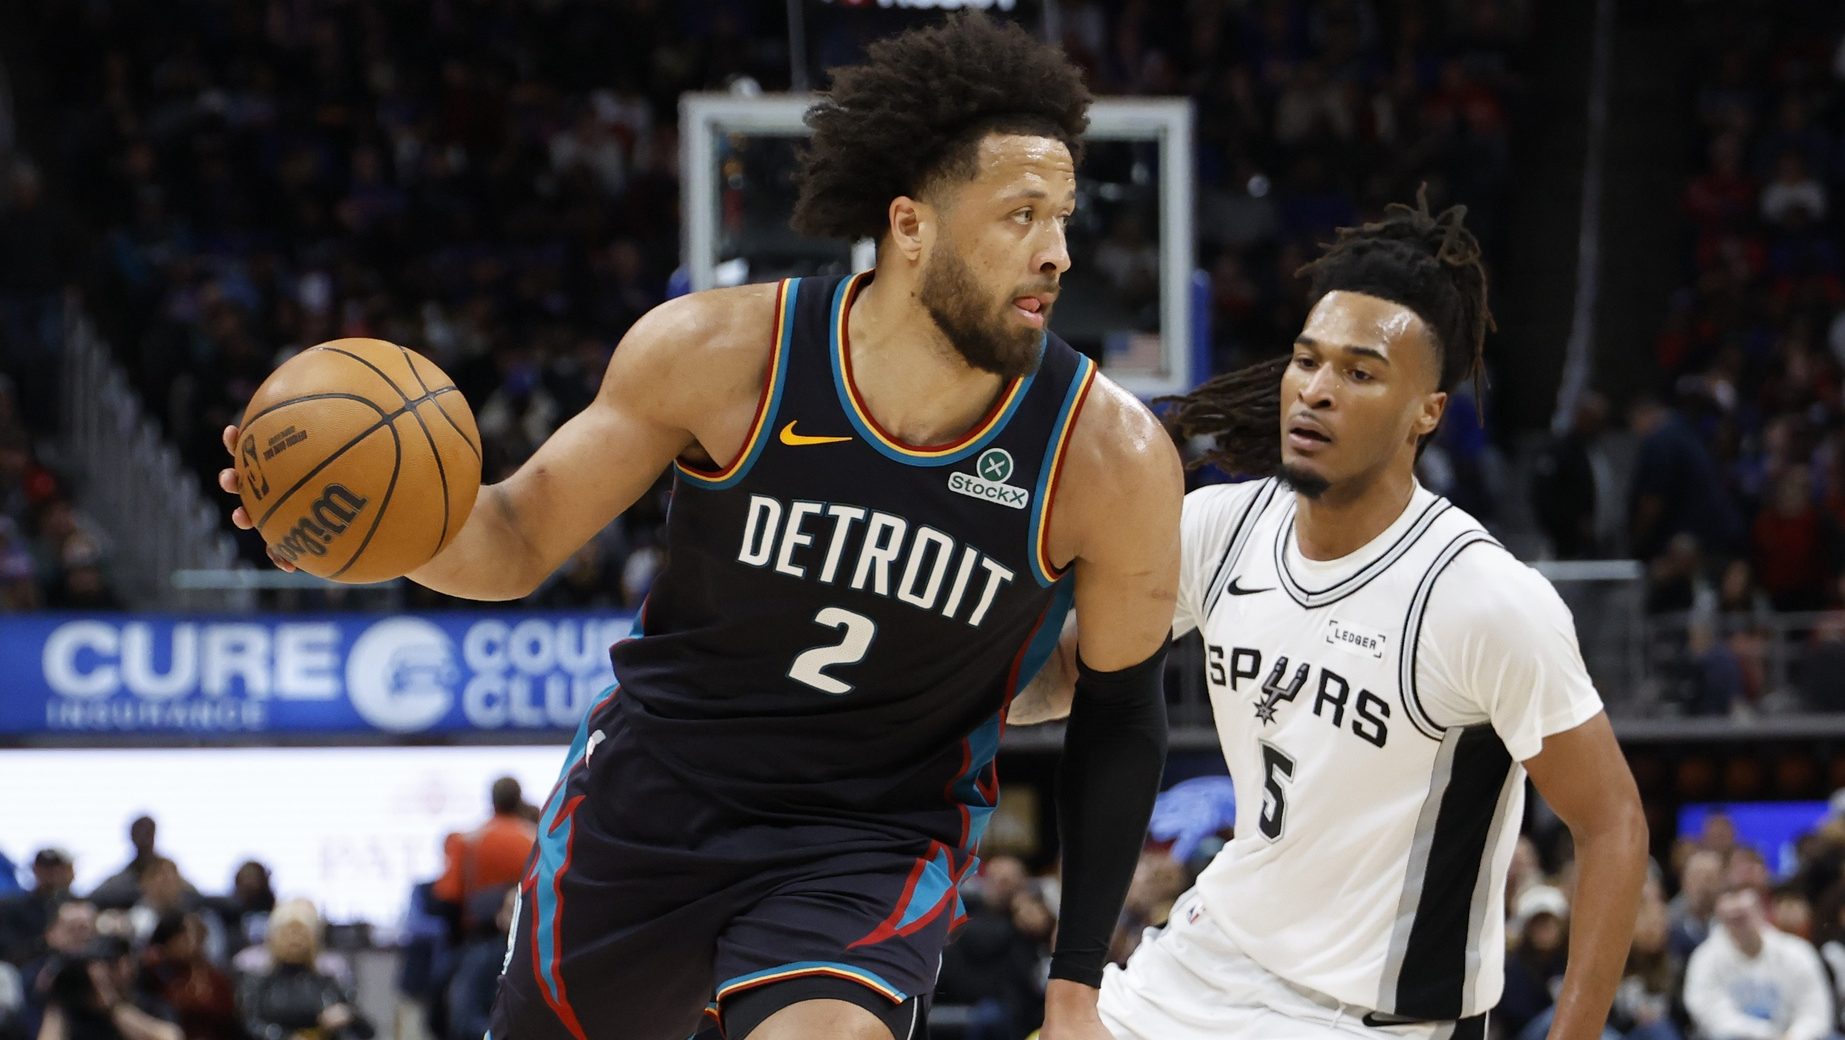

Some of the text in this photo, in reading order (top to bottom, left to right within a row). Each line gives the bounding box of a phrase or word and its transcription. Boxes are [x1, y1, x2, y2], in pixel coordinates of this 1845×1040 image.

[951, 475, 1026, 506] StockX
[736, 493, 1016, 628] DETROIT
[42, 620, 340, 699] CURE
[785, 606, 878, 694] 2
[1334, 628, 1377, 650] LEDGER
[1208, 644, 1391, 749] SPURS
[1258, 738, 1297, 844] 5
